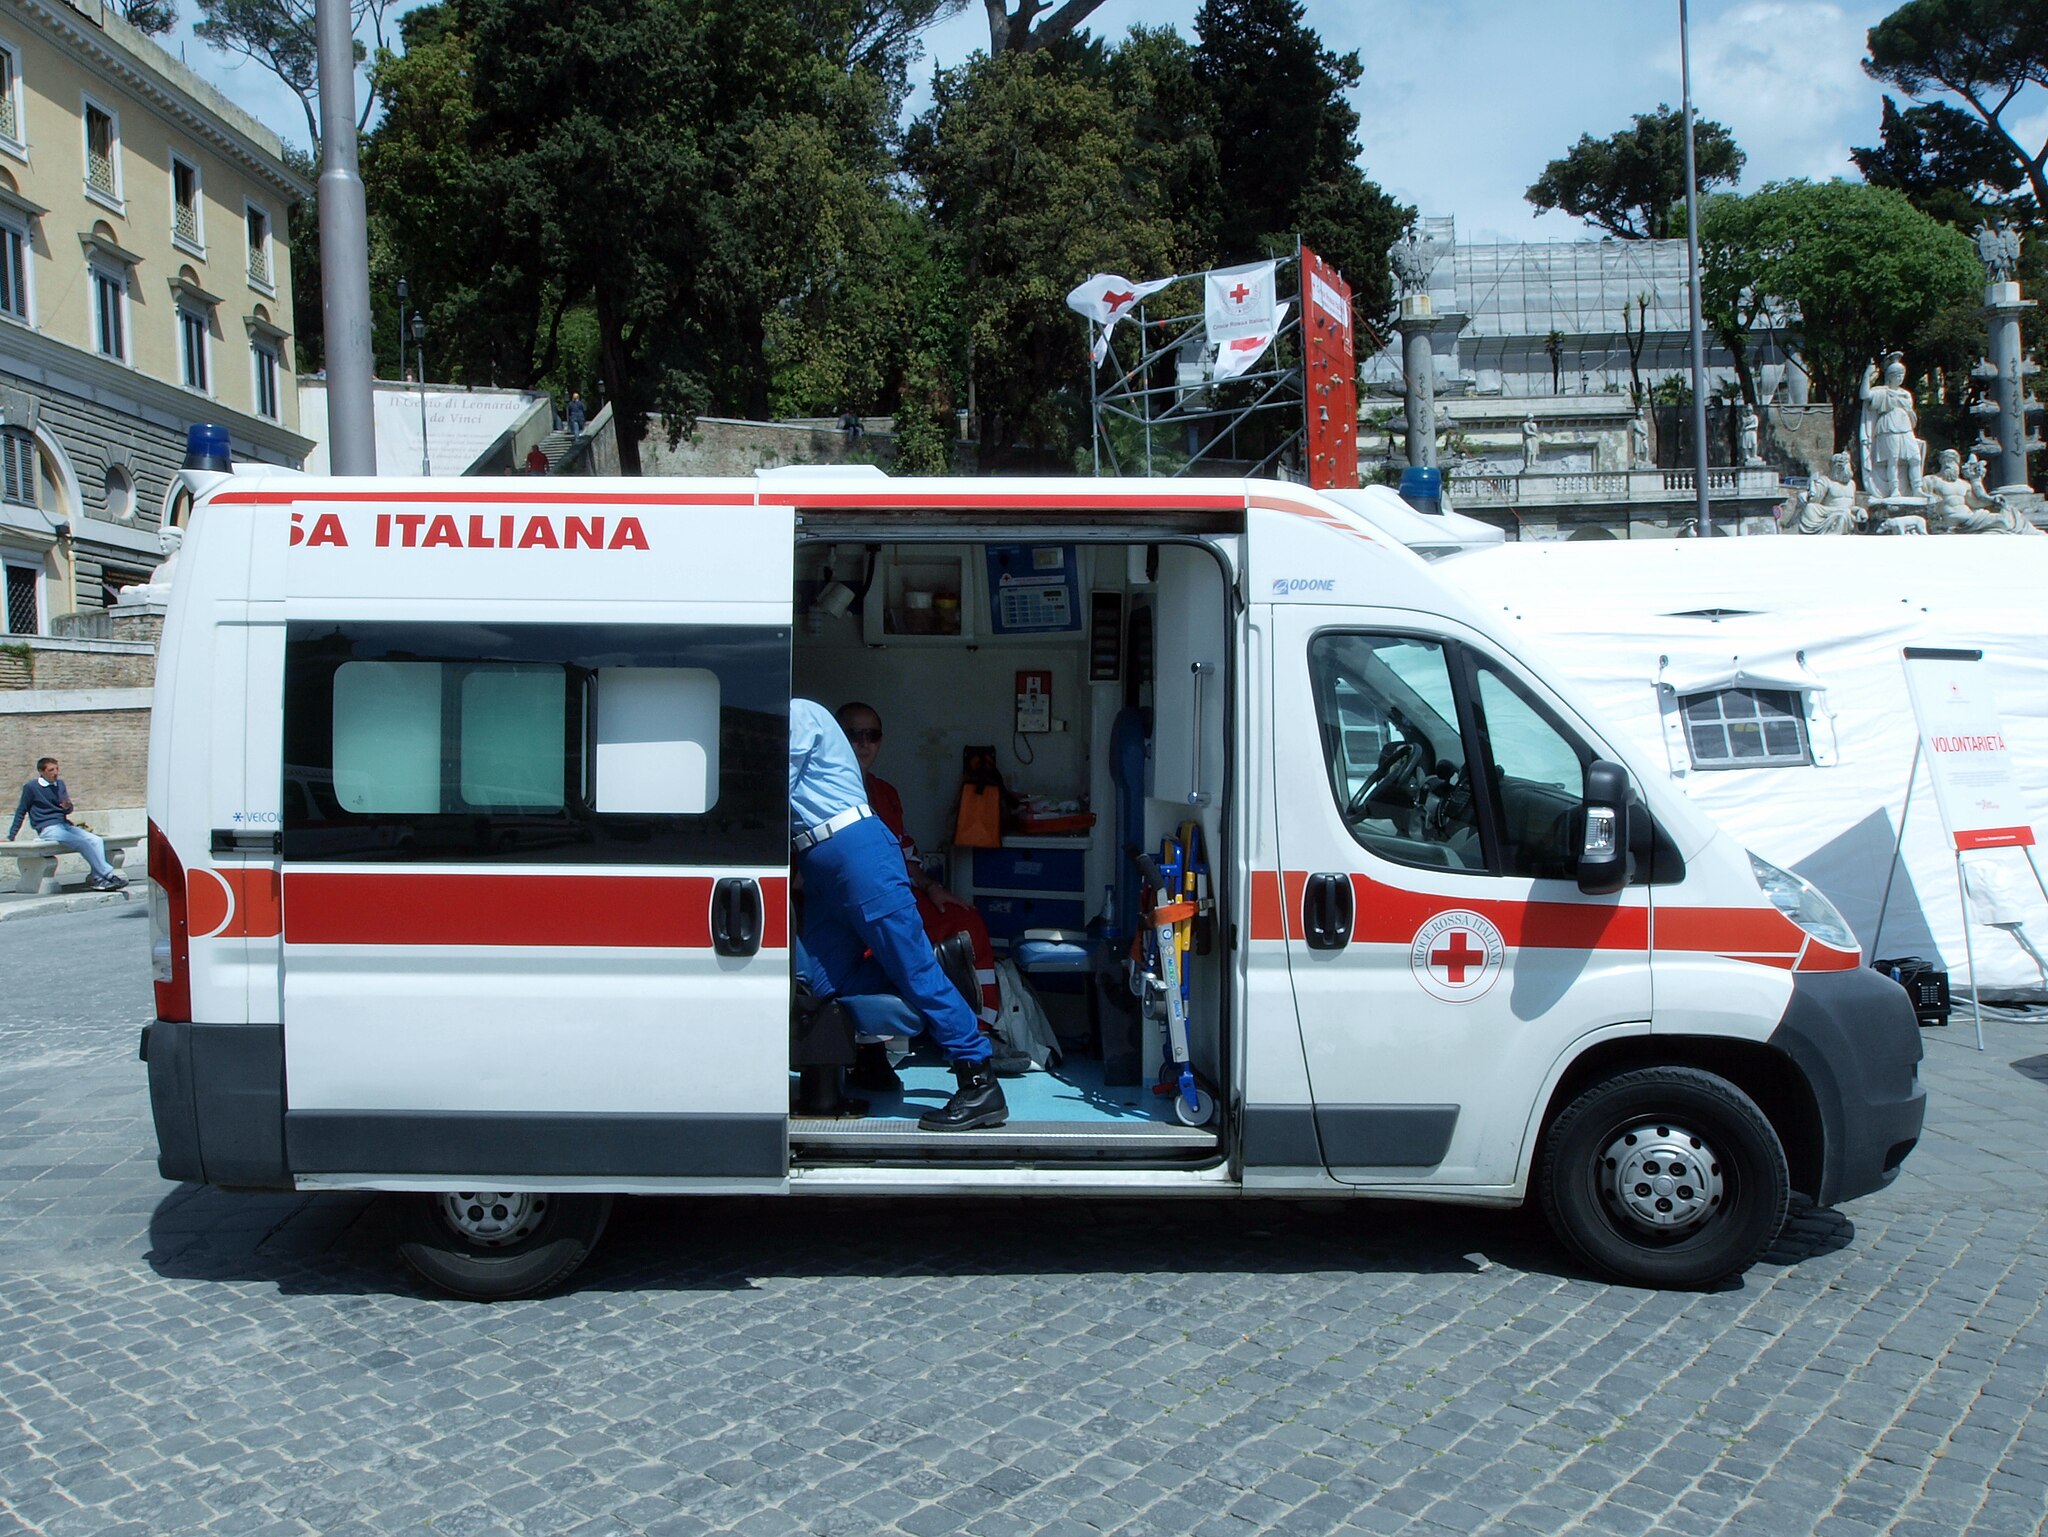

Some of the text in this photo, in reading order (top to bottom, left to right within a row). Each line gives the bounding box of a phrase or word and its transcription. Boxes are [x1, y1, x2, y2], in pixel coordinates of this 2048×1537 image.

[445, 398, 457, 409] di
[462, 399, 520, 410] Leonardo
[429, 412, 482, 424] da Vinci
[375, 513, 651, 550] ITALIANA
[1289, 578, 1336, 592] ODONE
[1931, 733, 2006, 752] VOLONTARIETÀ
[1414, 914, 1502, 968] CROCE ROSSA ITALIANA
